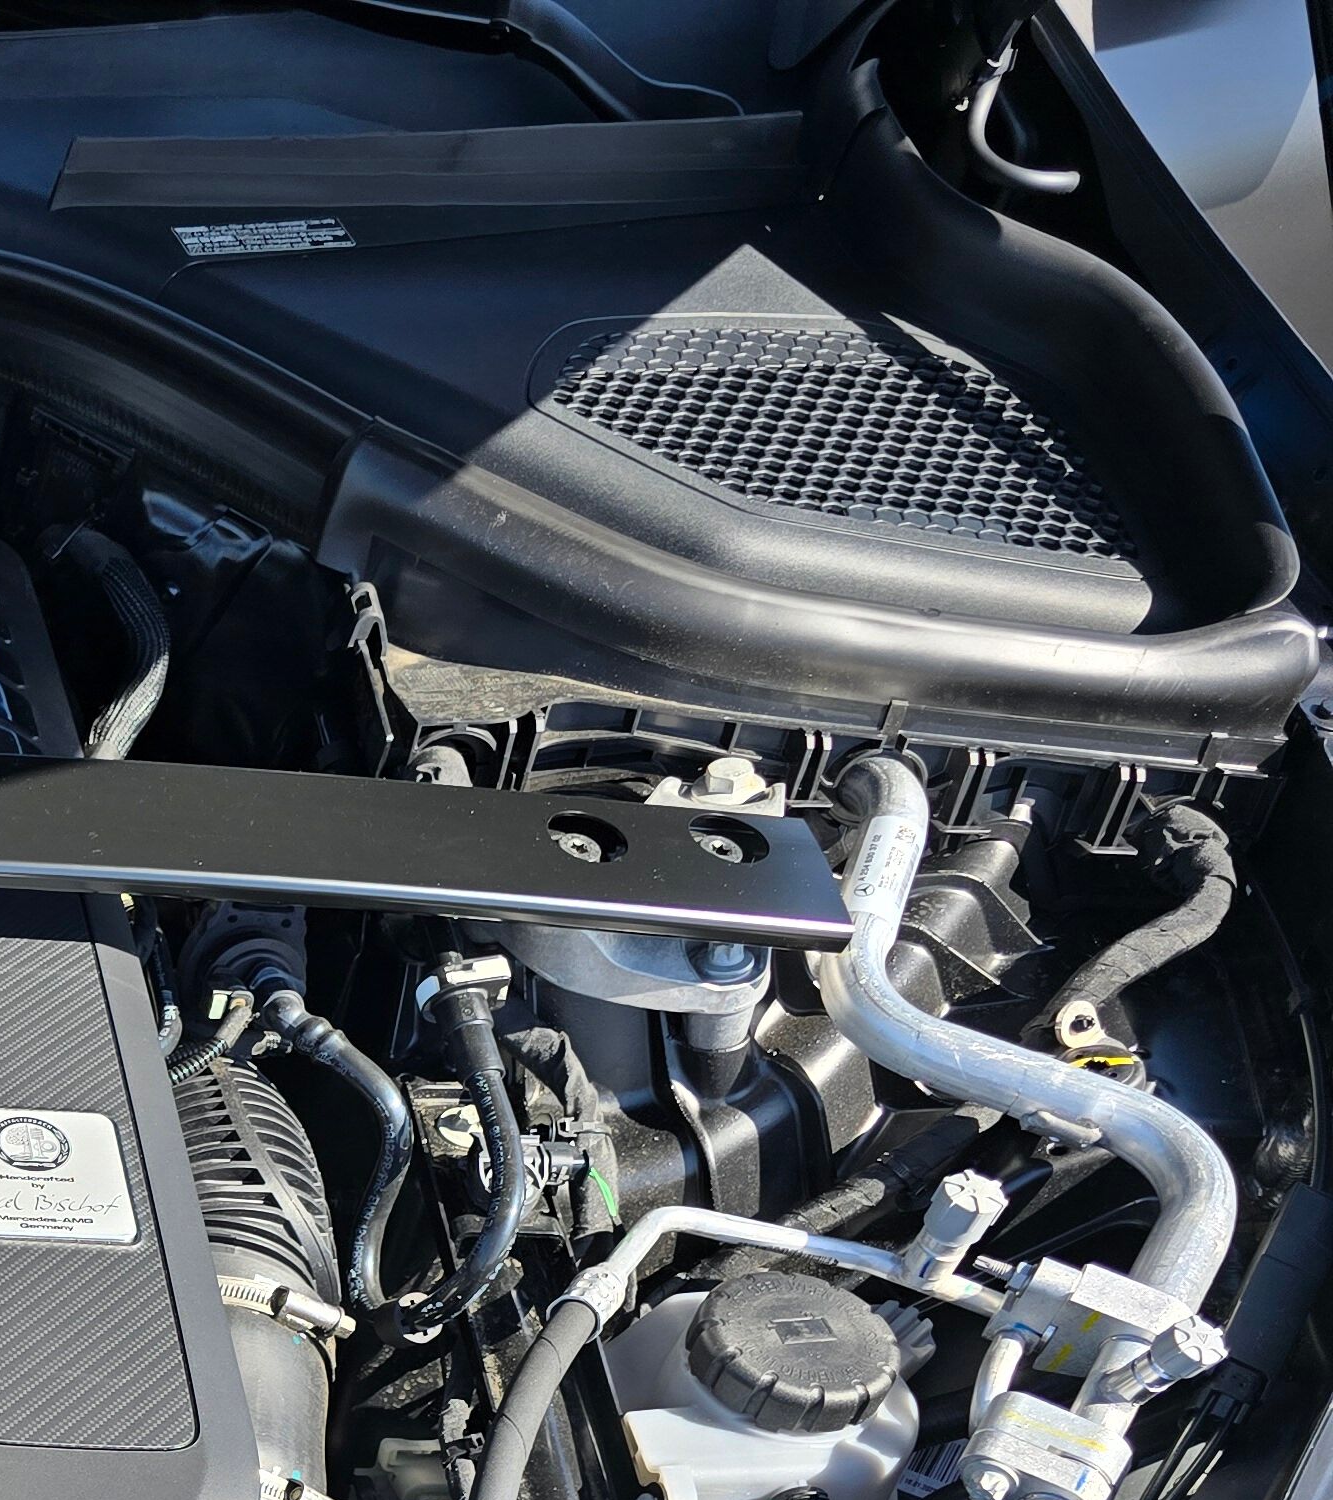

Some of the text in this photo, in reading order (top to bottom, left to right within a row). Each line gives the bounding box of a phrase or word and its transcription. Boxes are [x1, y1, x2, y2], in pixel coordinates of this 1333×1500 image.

[0, 1174, 75, 1184] Handcrafted
[31, 1182, 45, 1190] by
[19, 1222, 75, 1232] Germany
